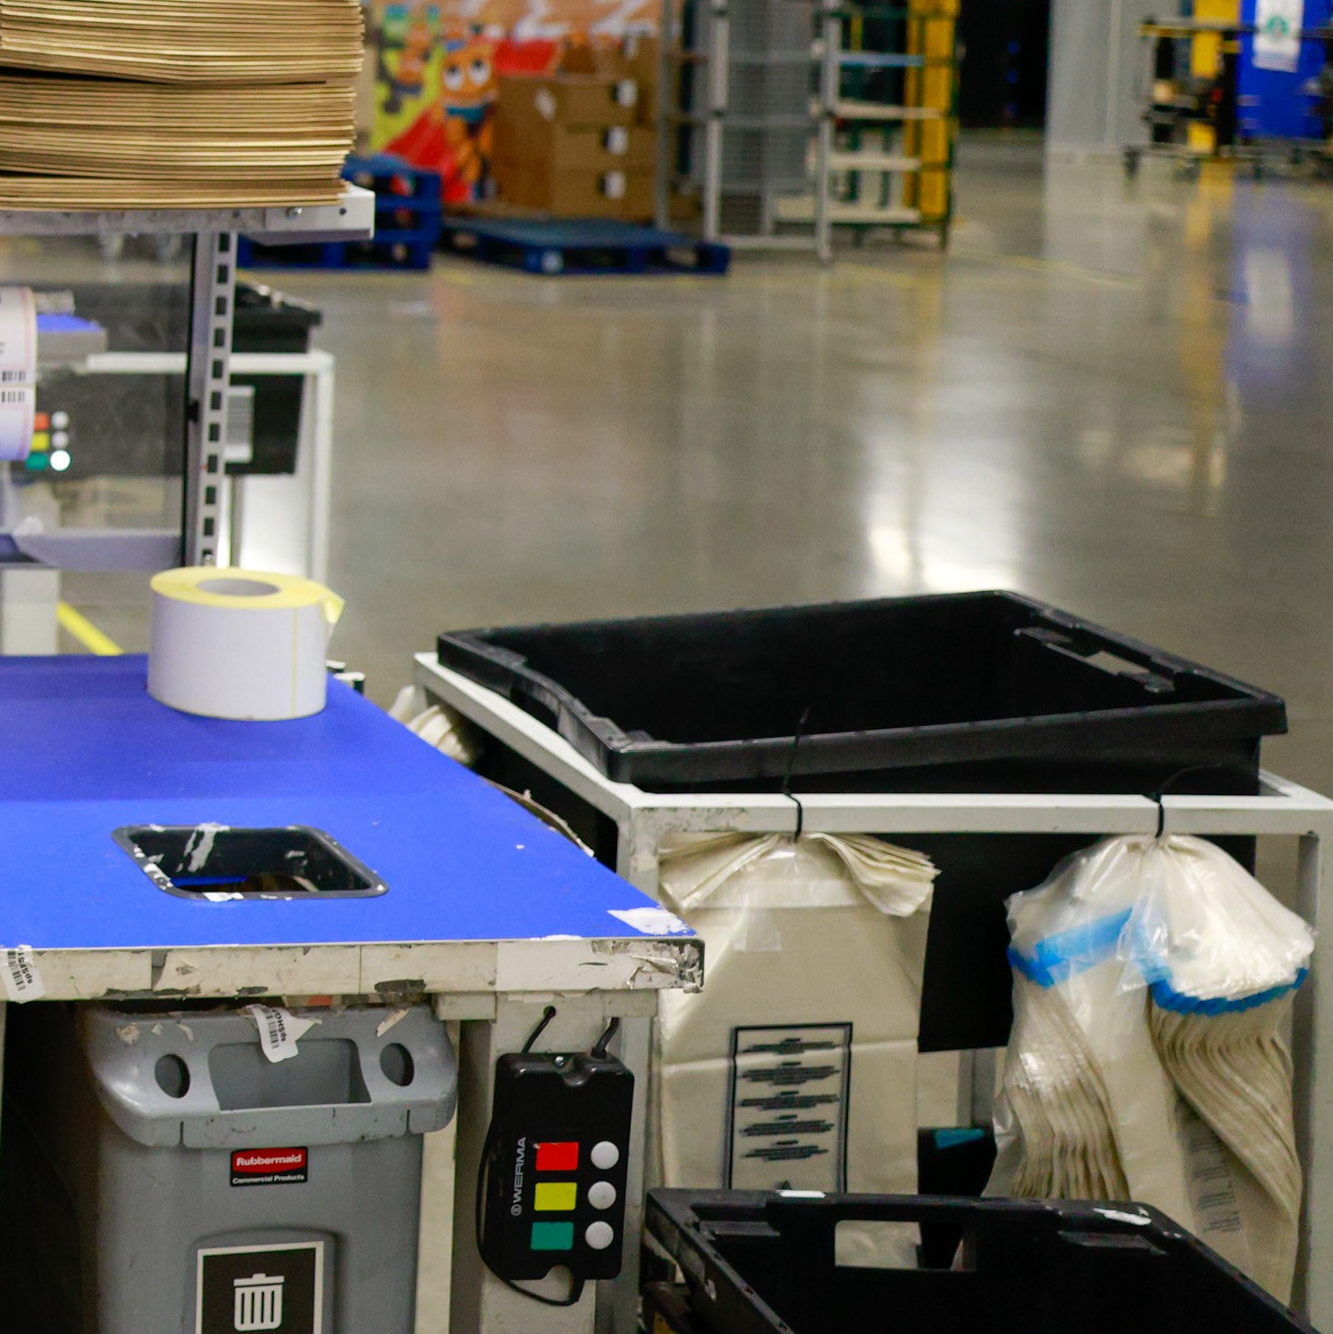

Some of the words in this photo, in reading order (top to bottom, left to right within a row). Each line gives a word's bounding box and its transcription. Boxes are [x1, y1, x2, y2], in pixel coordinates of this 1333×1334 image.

[236, 1154, 302, 1167] Rubbermaid
[513, 1137, 527, 1203] WERMA
[232, 1175, 273, 1185] Commercial
[273, 1174, 305, 1182] Products
